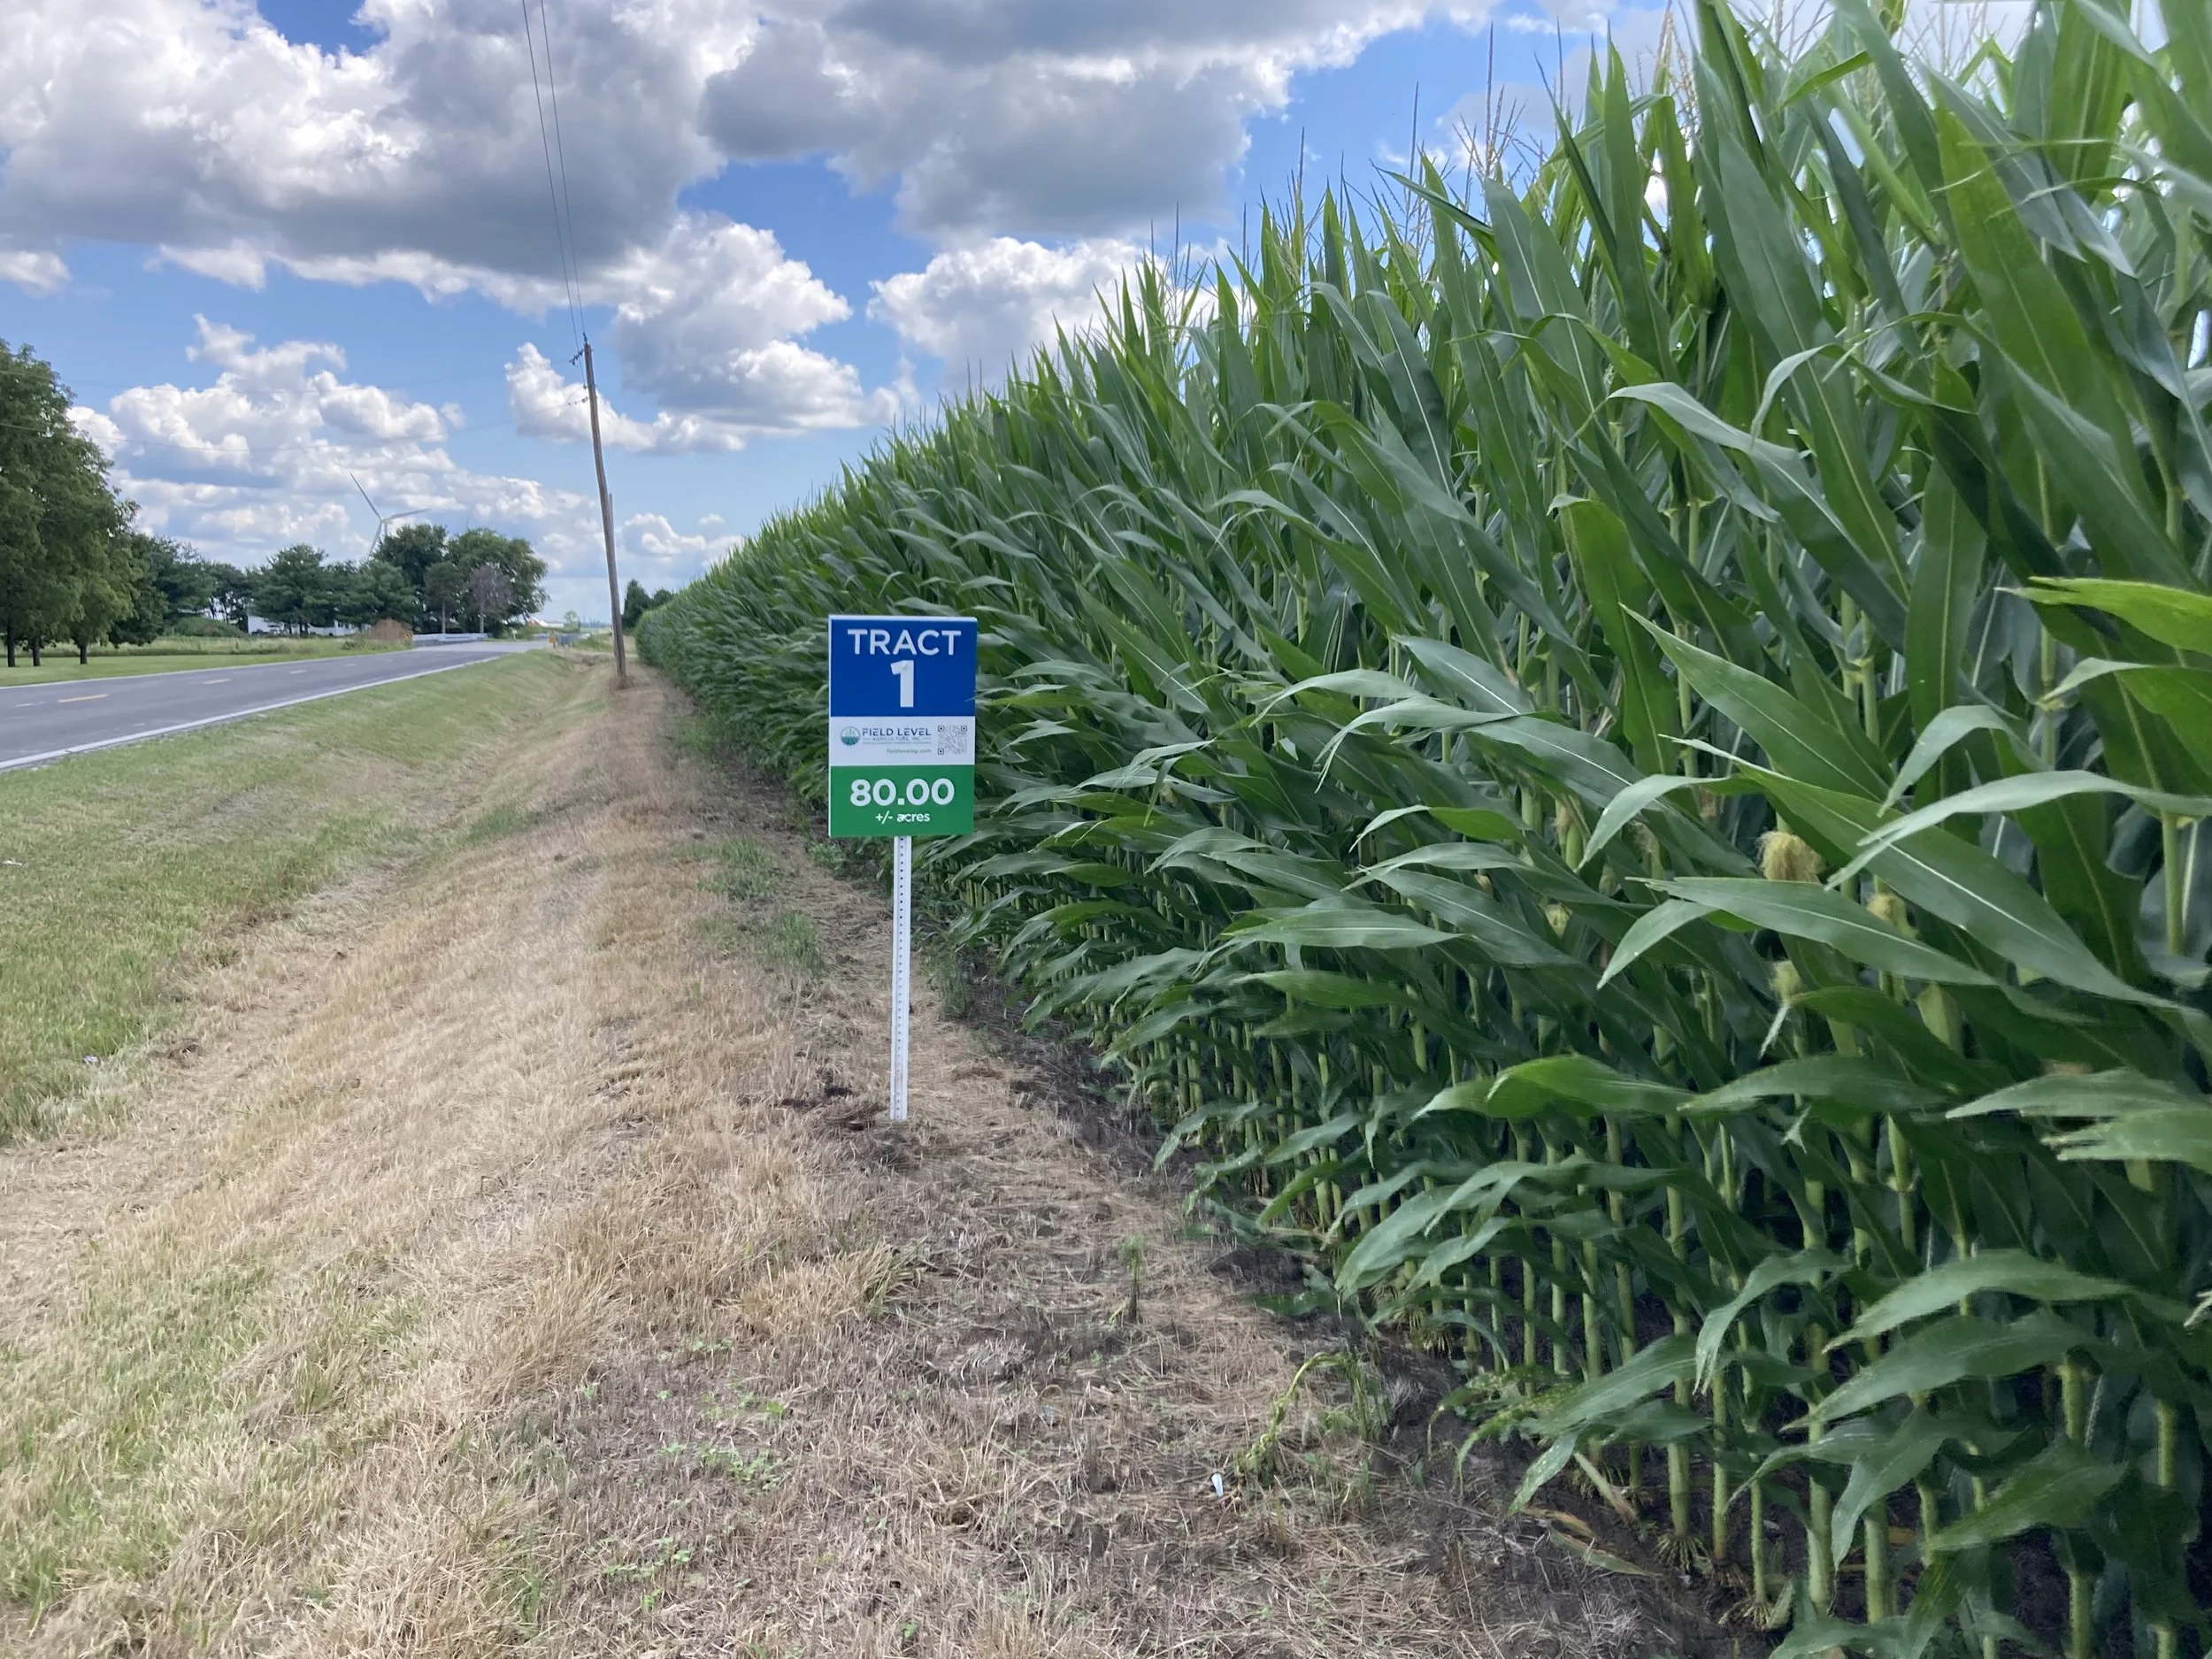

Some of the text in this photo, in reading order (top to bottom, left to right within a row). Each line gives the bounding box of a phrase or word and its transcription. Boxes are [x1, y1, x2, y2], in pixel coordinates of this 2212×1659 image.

[847, 628, 962, 656] TRACT
[890, 659, 915, 708] 1
[862, 727, 932, 736] FIELD LEVEL
[849, 778, 955, 806] 80.00
[875, 810, 931, 824] +/- acres
